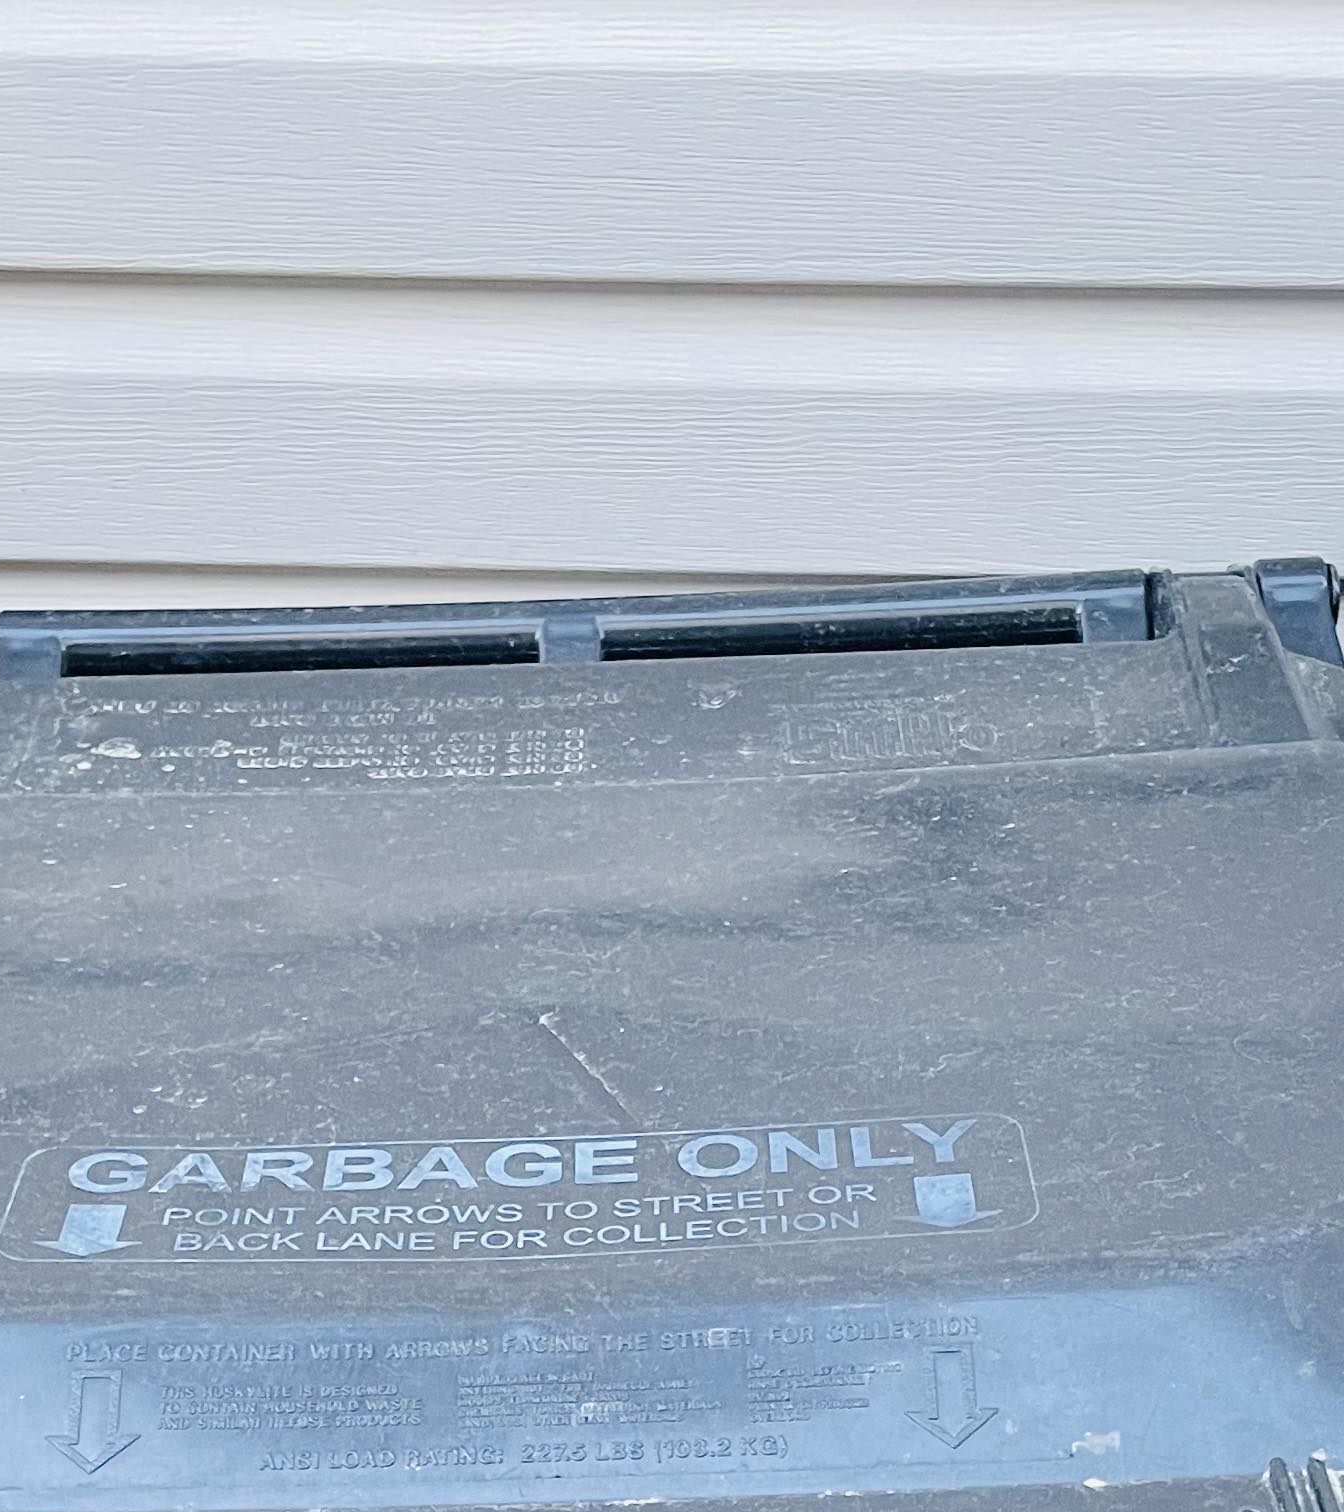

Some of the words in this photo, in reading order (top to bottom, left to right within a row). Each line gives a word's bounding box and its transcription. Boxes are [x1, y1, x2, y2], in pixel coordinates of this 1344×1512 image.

[68, 1139, 638, 1194] GARBAGE
[677, 1119, 977, 1178] ONLY
[162, 1207, 305, 1226] POINT
[315, 1203, 523, 1226] ARROWS
[538, 1201, 598, 1220] TO
[613, 1189, 793, 1218] STREET
[808, 1184, 877, 1204] OR
[173, 1232, 307, 1251] BACK
[316, 1231, 437, 1250] LANE
[453, 1230, 547, 1249] FOR
[563, 1210, 860, 1247] COLLECTION
[66, 1343, 148, 1362] PLACE
[158, 1343, 296, 1362] CONTAINER
[310, 1342, 375, 1360] WITH
[385, 1338, 489, 1360] ARROWS
[503, 1333, 590, 1354] FACING
[603, 1333, 649, 1352] THE
[660, 1327, 752, 1350] STREET
[768, 1326, 815, 1346] FOR
[826, 1315, 978, 1343] COLLECTION
[298, 1384, 314, 1398] IS
[365, 1398, 424, 1414] WASTE
[258, 1452, 321, 1471] ANSI
[327, 1449, 397, 1470] LOAD
[406, 1445, 504, 1468] RATING:
[520, 1442, 588, 1464] 227.5
[594, 1441, 645, 1462] LBS
[740, 1433, 789, 1459] KG)
